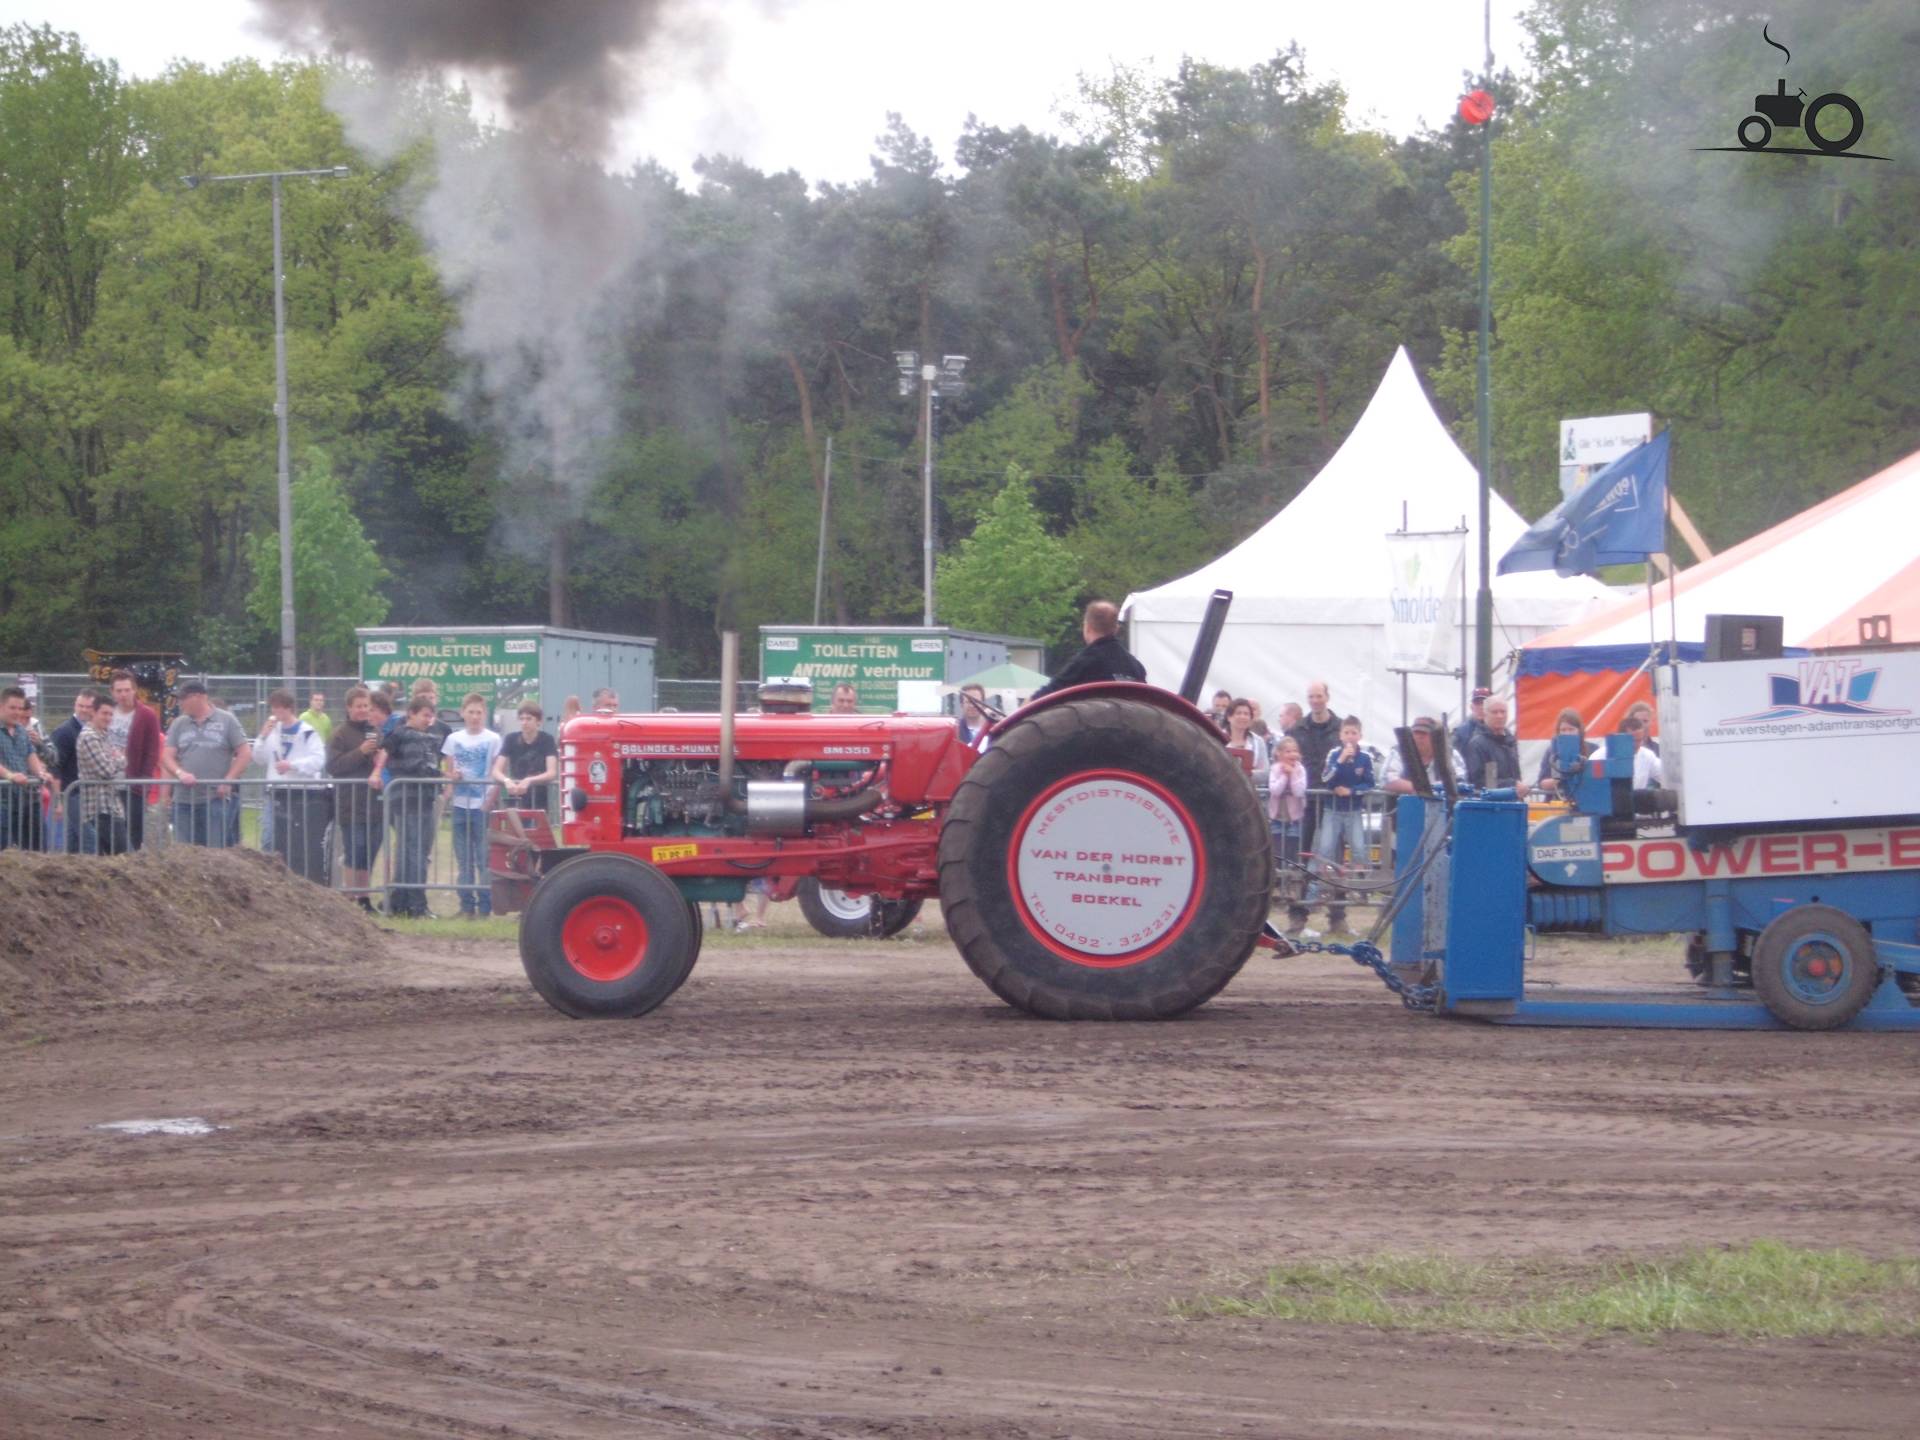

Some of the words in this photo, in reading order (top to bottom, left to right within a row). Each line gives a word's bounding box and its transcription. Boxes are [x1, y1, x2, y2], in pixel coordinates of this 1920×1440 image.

[407, 645, 492, 658] TOILETTEN
[812, 644, 898, 658] TOILETTEN
[378, 662, 448, 677] ANTONIS
[452, 660, 525, 676] verhuur
[793, 663, 857, 678] ANTONIS
[863, 664, 933, 678] verhuur
[1798, 658, 1862, 705] VAT
[1037, 788, 1180, 845] MESTDISTRIBUTIE
[1031, 849, 1067, 860] VAN
[1076, 851, 1113, 863] DER
[1121, 853, 1186, 866] HORST
[1536, 848, 1558, 859] DAF
[1560, 847, 1592, 857] Trucks
[1053, 871, 1162, 888] TRANSPORT
[1071, 893, 1142, 907] BOEKEL
